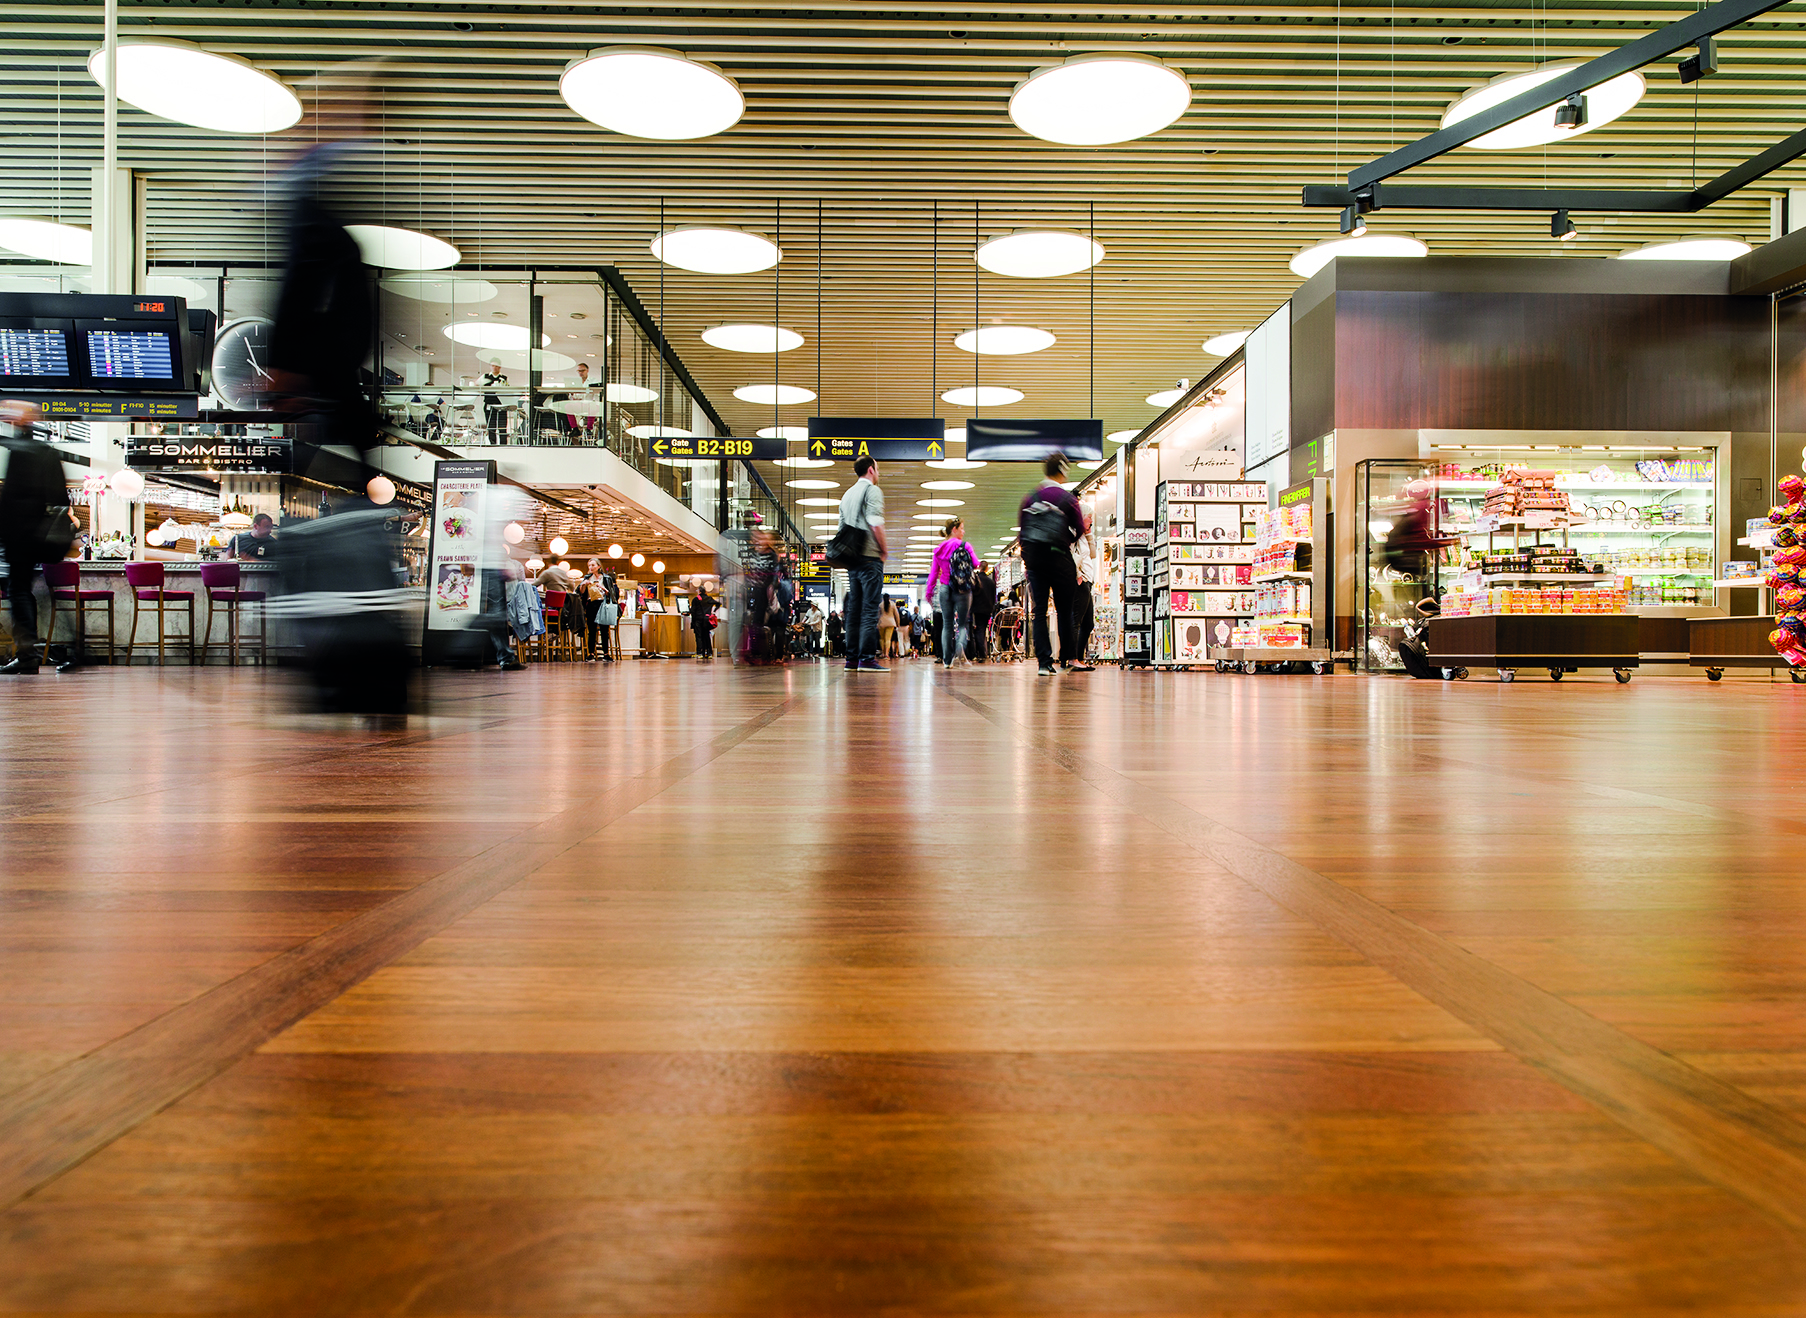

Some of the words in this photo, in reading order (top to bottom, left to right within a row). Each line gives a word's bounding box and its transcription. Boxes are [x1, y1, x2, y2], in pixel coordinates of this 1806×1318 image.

[140, 302, 165, 313] 11:20
[42, 402, 50, 412] D
[120, 403, 127, 414] F
[671, 438, 690, 447] Gate
[671, 446, 694, 455] Gates
[697, 439, 754, 456] B2-B19
[831, 439, 854, 447] Gates
[831, 447, 854, 456] Gates
[857, 440, 870, 456] A
[148, 444, 283, 457] SOMMELIER
